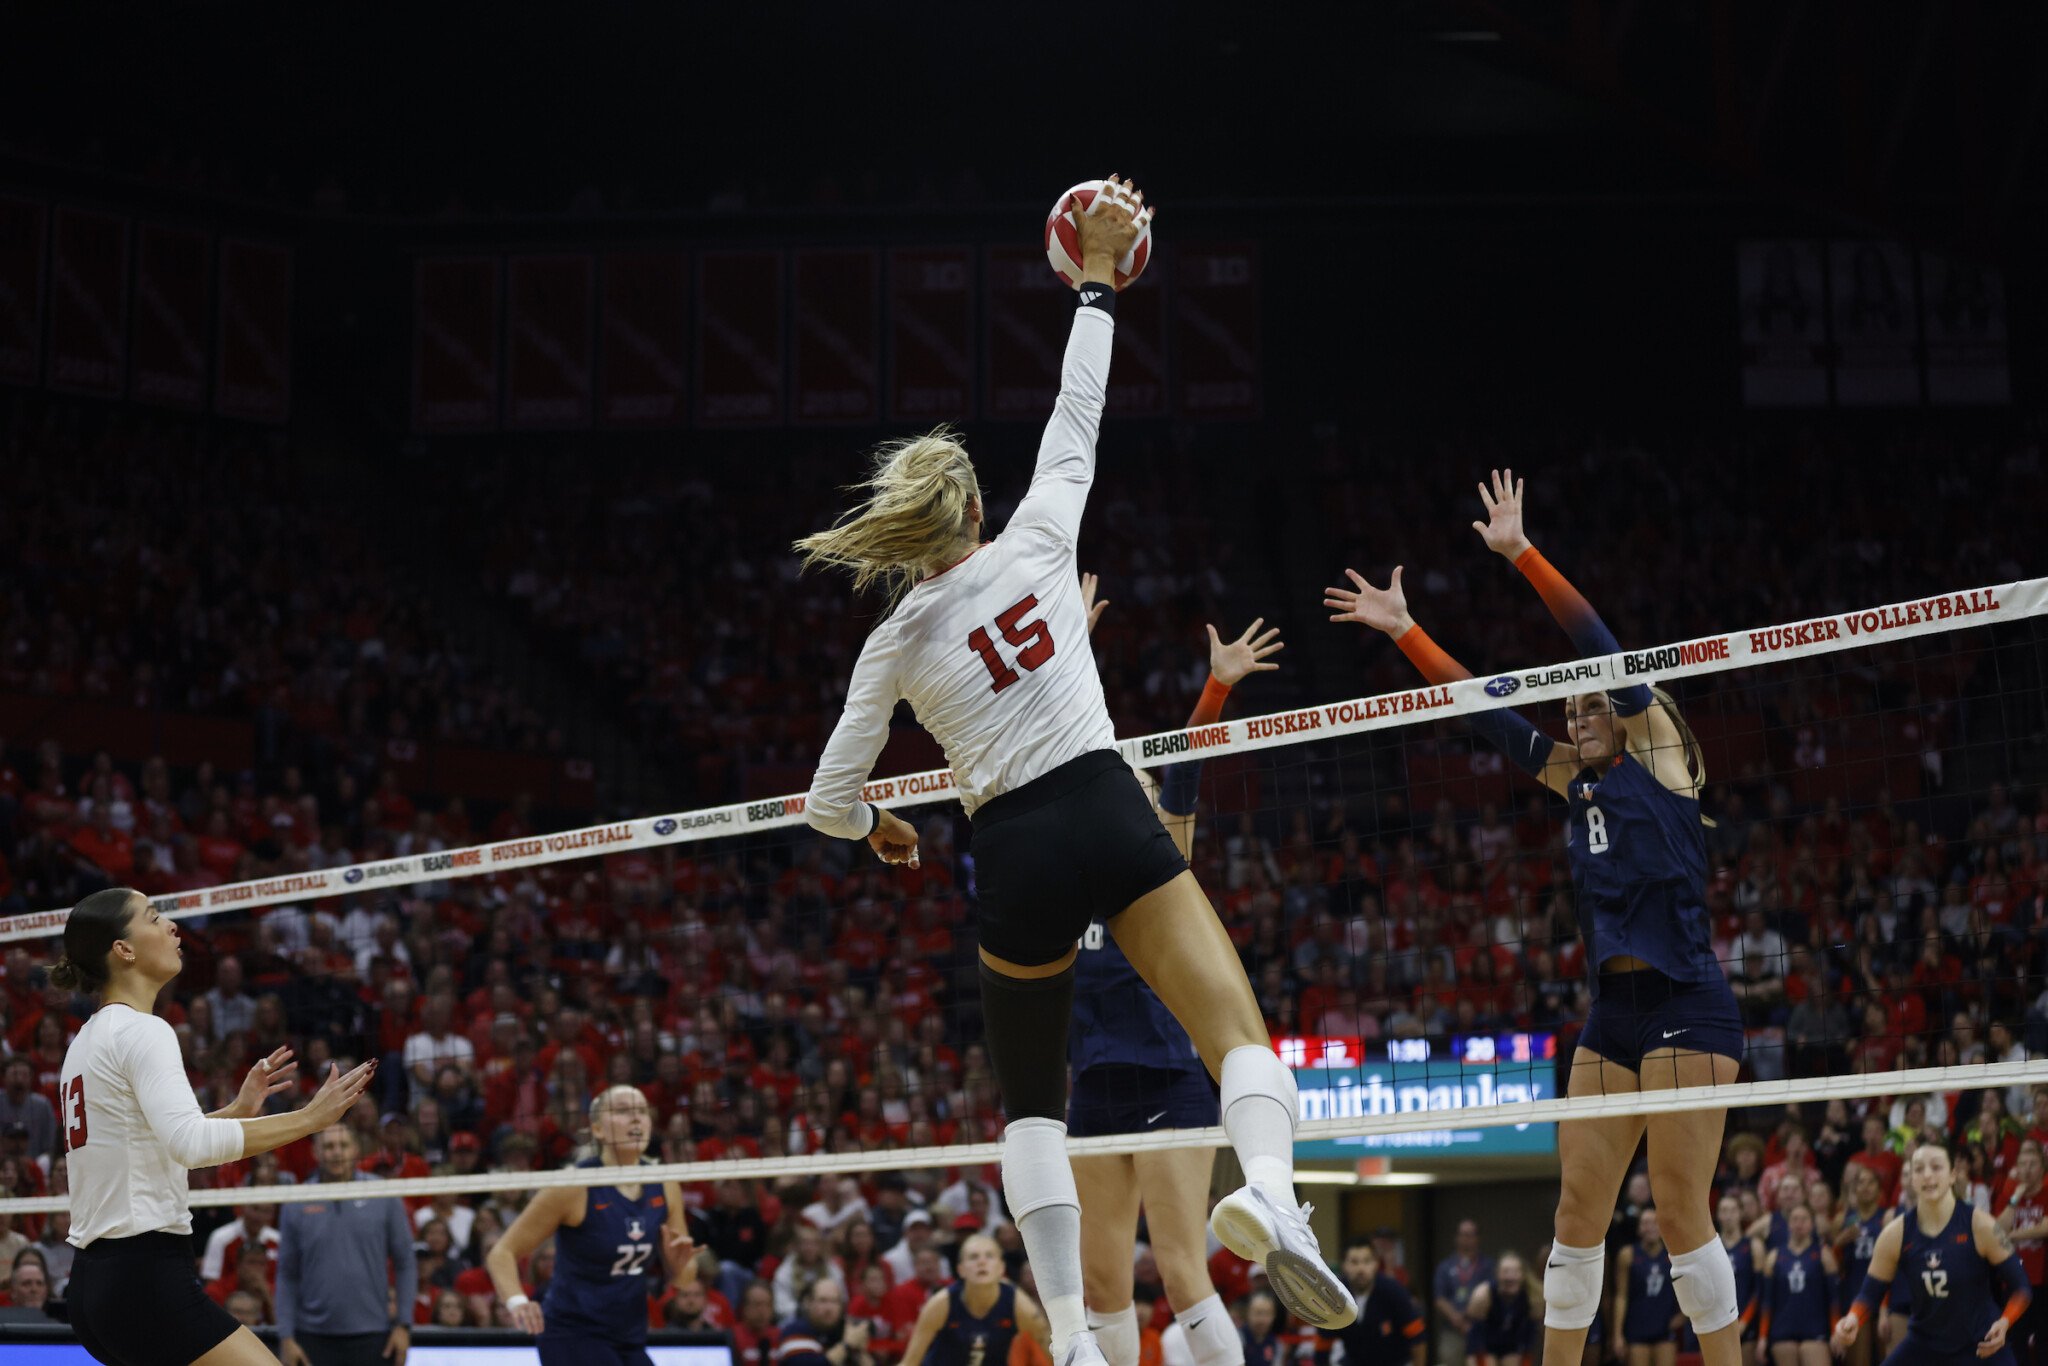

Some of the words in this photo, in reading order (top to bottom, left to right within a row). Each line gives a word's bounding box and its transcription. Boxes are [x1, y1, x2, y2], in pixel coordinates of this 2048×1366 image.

[1750, 618, 1840, 654] HUSKER
[1844, 589, 1999, 636] VOLLEYBALL
[968, 593, 1055, 694] 15
[1624, 638, 1729, 675] BEARDMORE
[1525, 662, 1600, 689] SUBARU
[1247, 709, 1321, 740] HUSKER
[1326, 687, 1454, 726] VOLLEYBALL
[1142, 726, 1230, 758] BEARDMORE
[862, 782, 894, 802] KER
[898, 771, 956, 796] VOLLEY
[681, 812, 732, 830] SUBARU
[747, 797, 806, 822] BEARDMO
[491, 840, 543, 862] HUSKER
[545, 825, 633, 854] VOLLEYBALL
[1586, 805, 1609, 854] 8
[422, 849, 481, 873] BEARDMORE
[62, 1074, 88, 1153] 13
[1299, 1073, 1541, 1131] mithpauley
[609, 1243, 653, 1277] 22
[1921, 1269, 1949, 1299] 12
